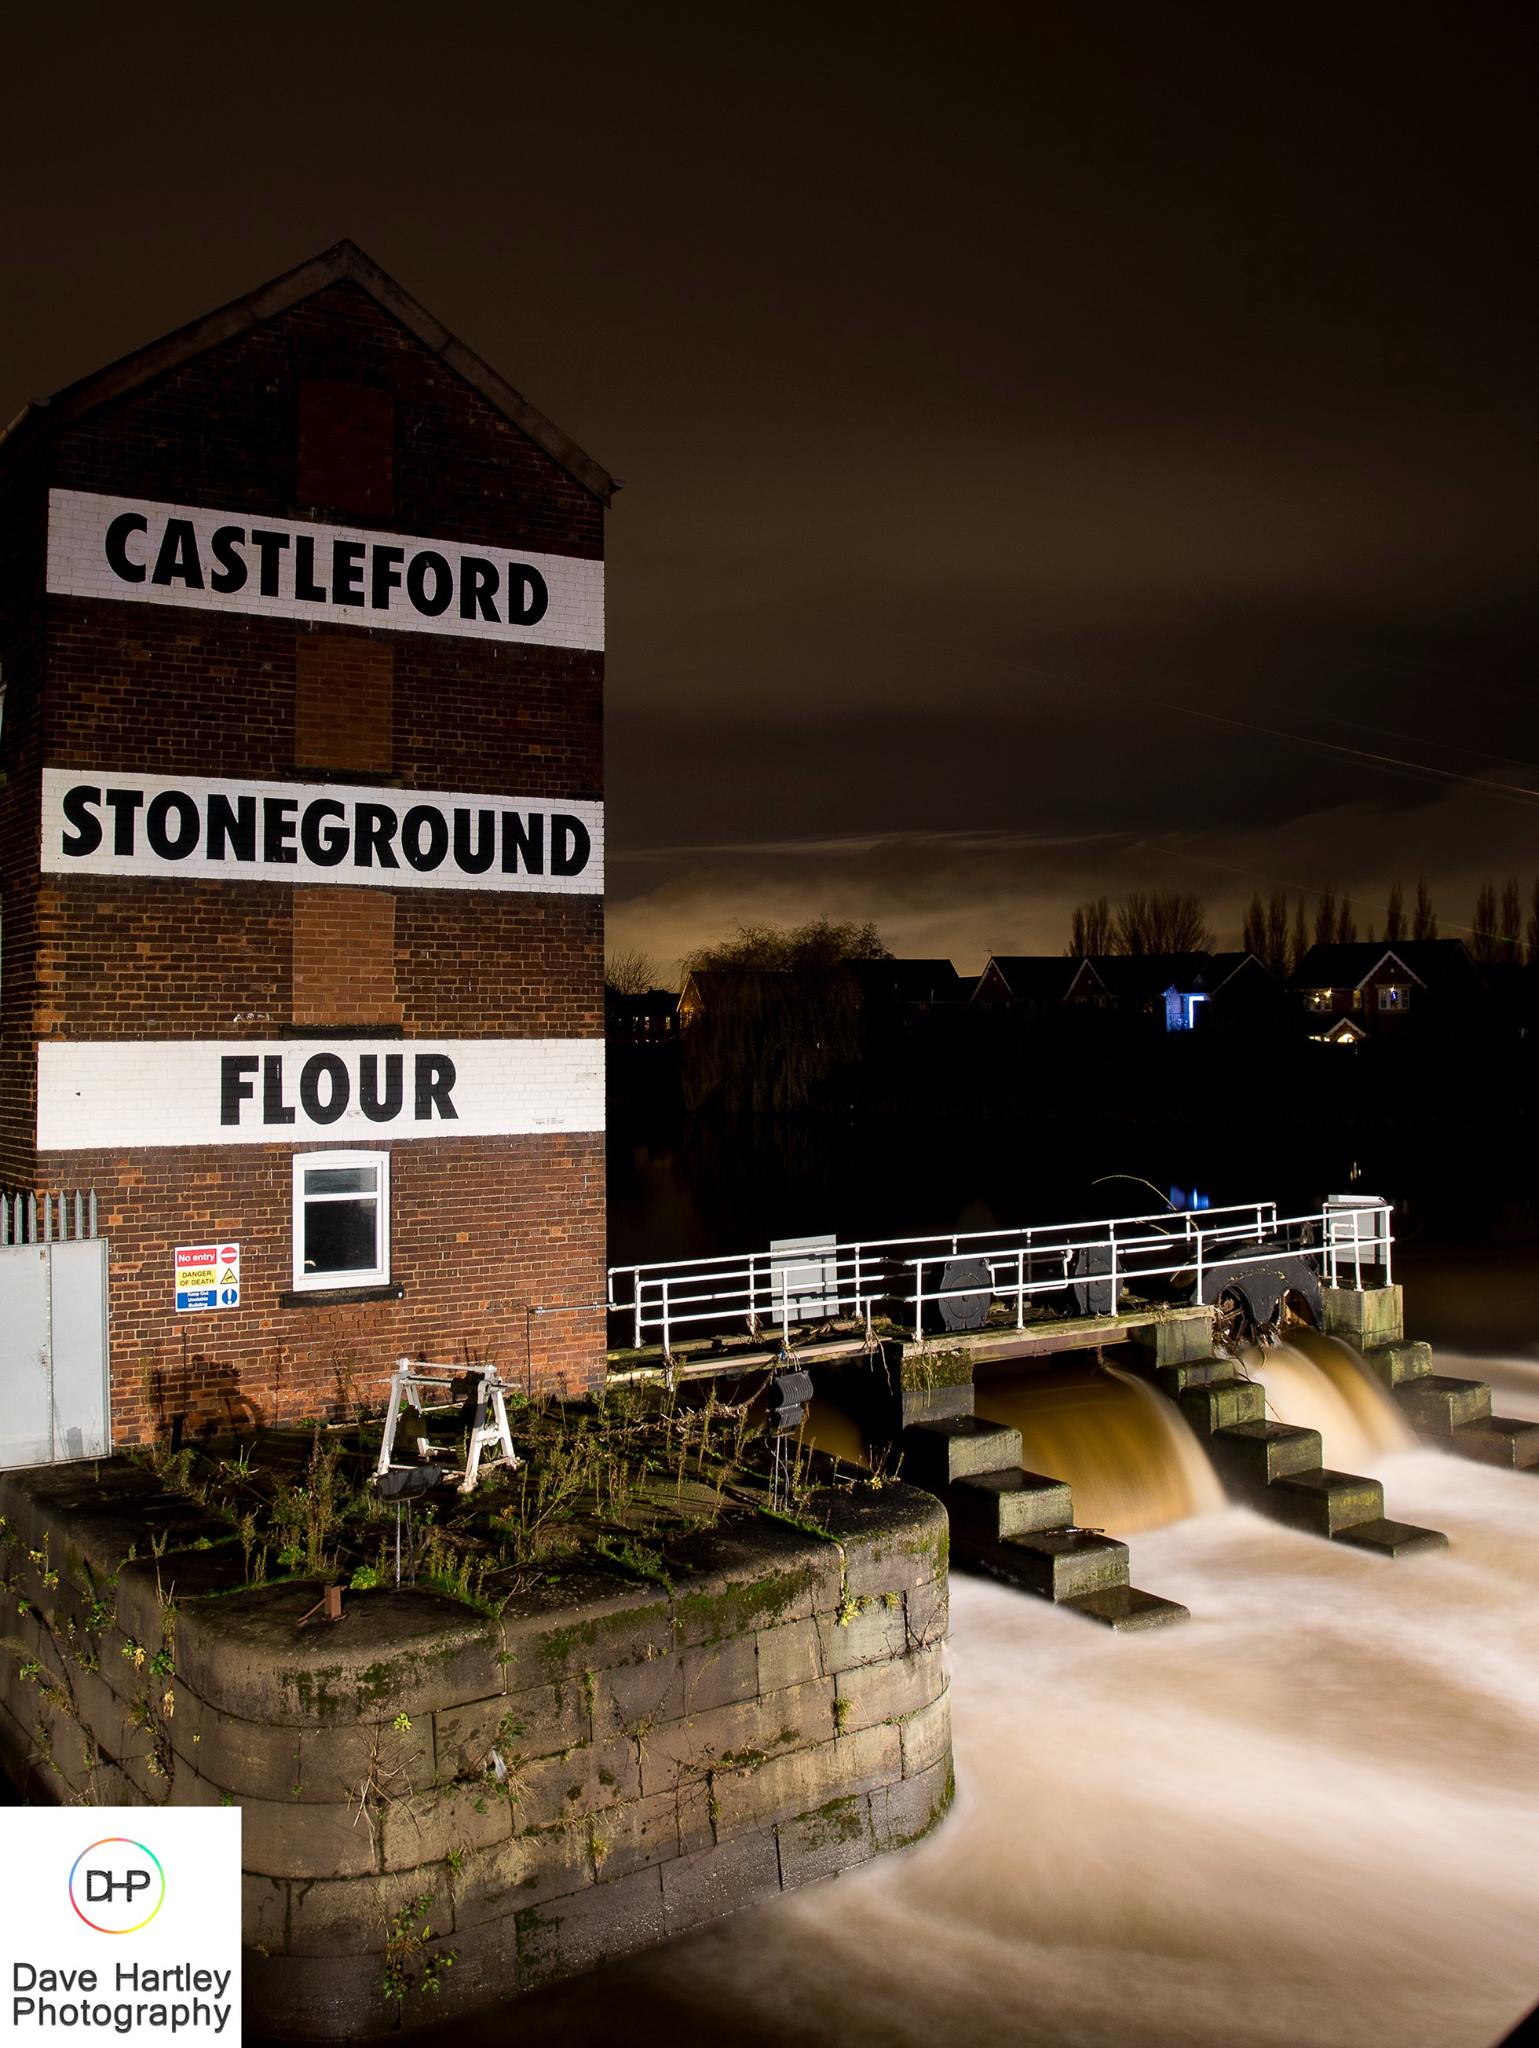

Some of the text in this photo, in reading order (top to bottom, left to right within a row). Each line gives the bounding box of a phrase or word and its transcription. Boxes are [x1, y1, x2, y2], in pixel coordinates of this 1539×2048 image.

[105, 513, 549, 626] CASTLEFORD
[62, 785, 590, 876] STONEGROUND
[220, 1053, 459, 1125] FLOUR
[178, 1253, 215, 1262] No entry
[182, 1270, 212, 1278] DANGER
